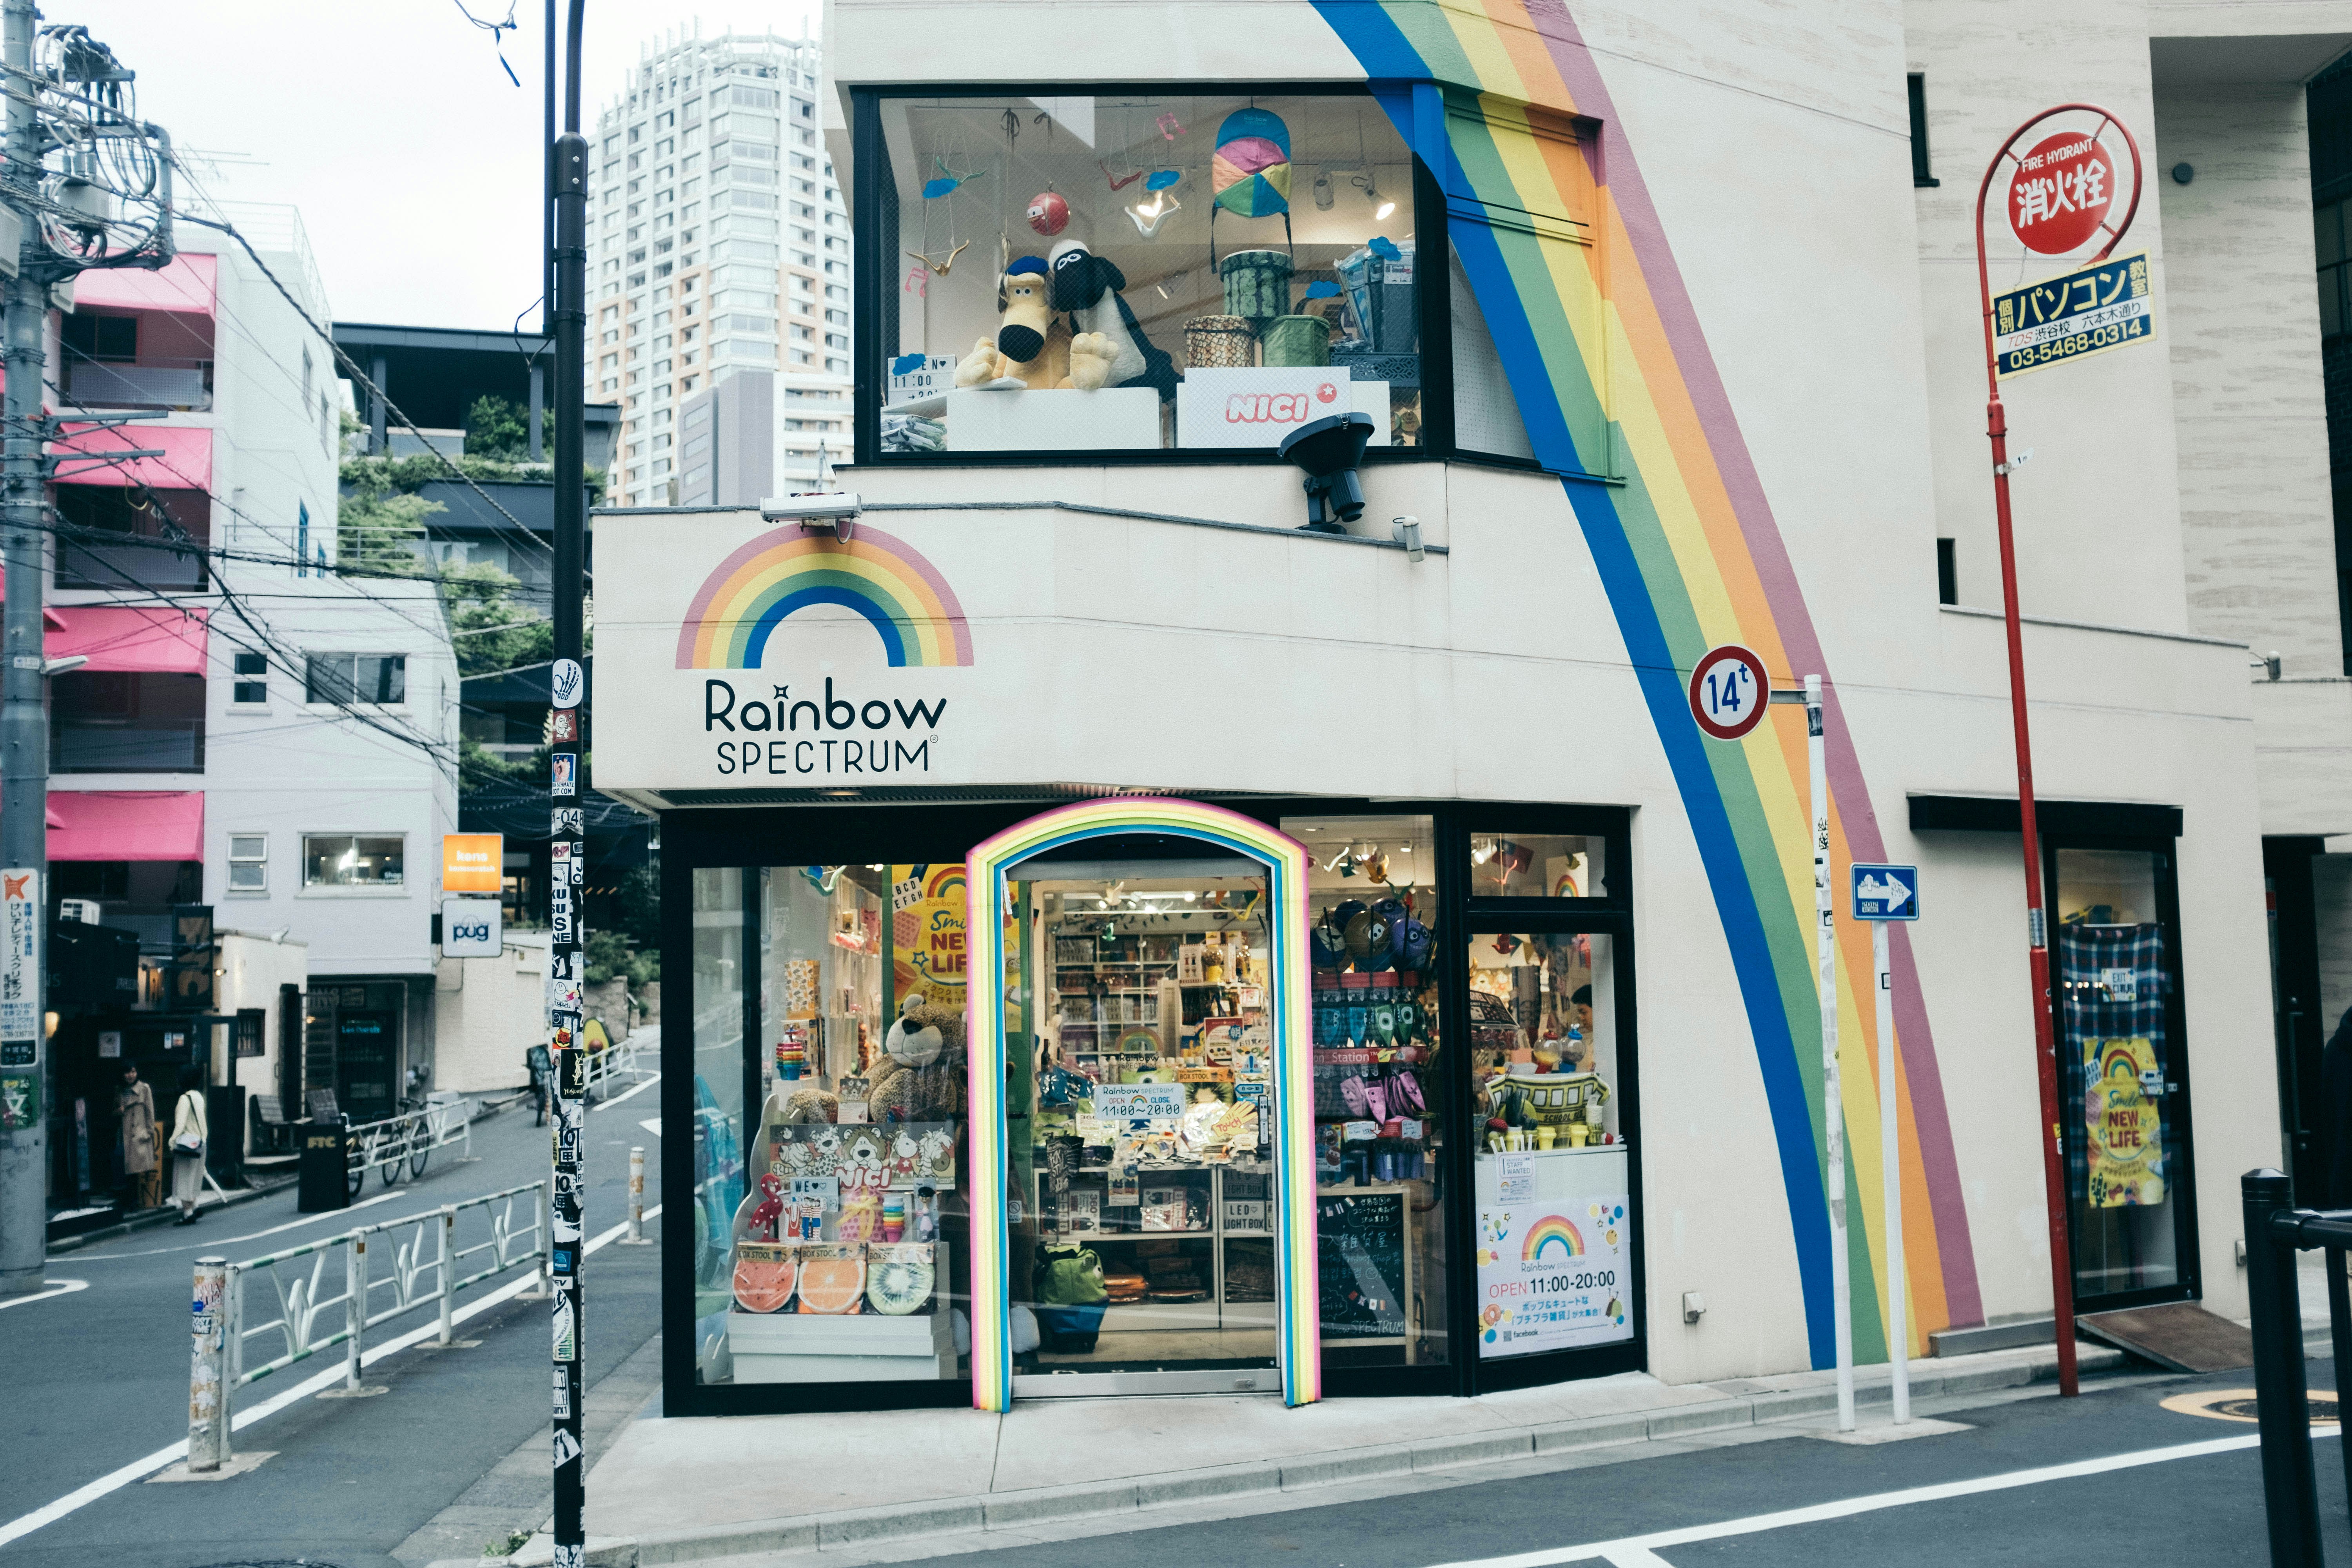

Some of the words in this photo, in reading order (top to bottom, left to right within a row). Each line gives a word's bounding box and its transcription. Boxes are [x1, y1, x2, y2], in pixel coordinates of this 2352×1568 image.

[2022, 154, 2044, 172] FIRE
[2047, 138, 2094, 165] HYDRANT
[2015, 158, 2108, 229] 消火栓
[2129, 260, 2148, 298] 教室
[2017, 270, 2126, 329] パソコン
[1998, 298, 2014, 334] 個別
[2008, 332, 2033, 348] TDS
[2035, 321, 2071, 342] 渋谷校
[2082, 302, 2141, 329] 六本木通り
[2010, 319, 2143, 369] 03-5468-0314
[894, 375, 931, 388] 11:00
[1225, 393, 1309, 423] NICI
[706, 677, 947, 732] Rainbow
[453, 924, 489, 943] pug
[1119, 1053, 1159, 1062] Rainbow
[1103, 1086, 1140, 1095] Rainbow
[2108, 1110, 2139, 1127] NEW
[2109, 1130, 2141, 1148] LIFE
[795, 1180, 809, 1192] WE
[833, 1166, 893, 1189] NICI
[1230, 1205, 1250, 1216] LED
[1249, 1219, 1264, 1229] BOX
[752, 1250, 771, 1259] STOOL
[817, 1249, 837, 1258] STOOL
[1521, 1262, 1555, 1273] Rainbow
[1489, 1281, 1527, 1298] OPEN
[1530, 1270, 1615, 1294] 11:00-20:00
[1352, 1320, 1404, 1334] SPECTRUM
[1514, 1329, 1538, 1338] facebook
